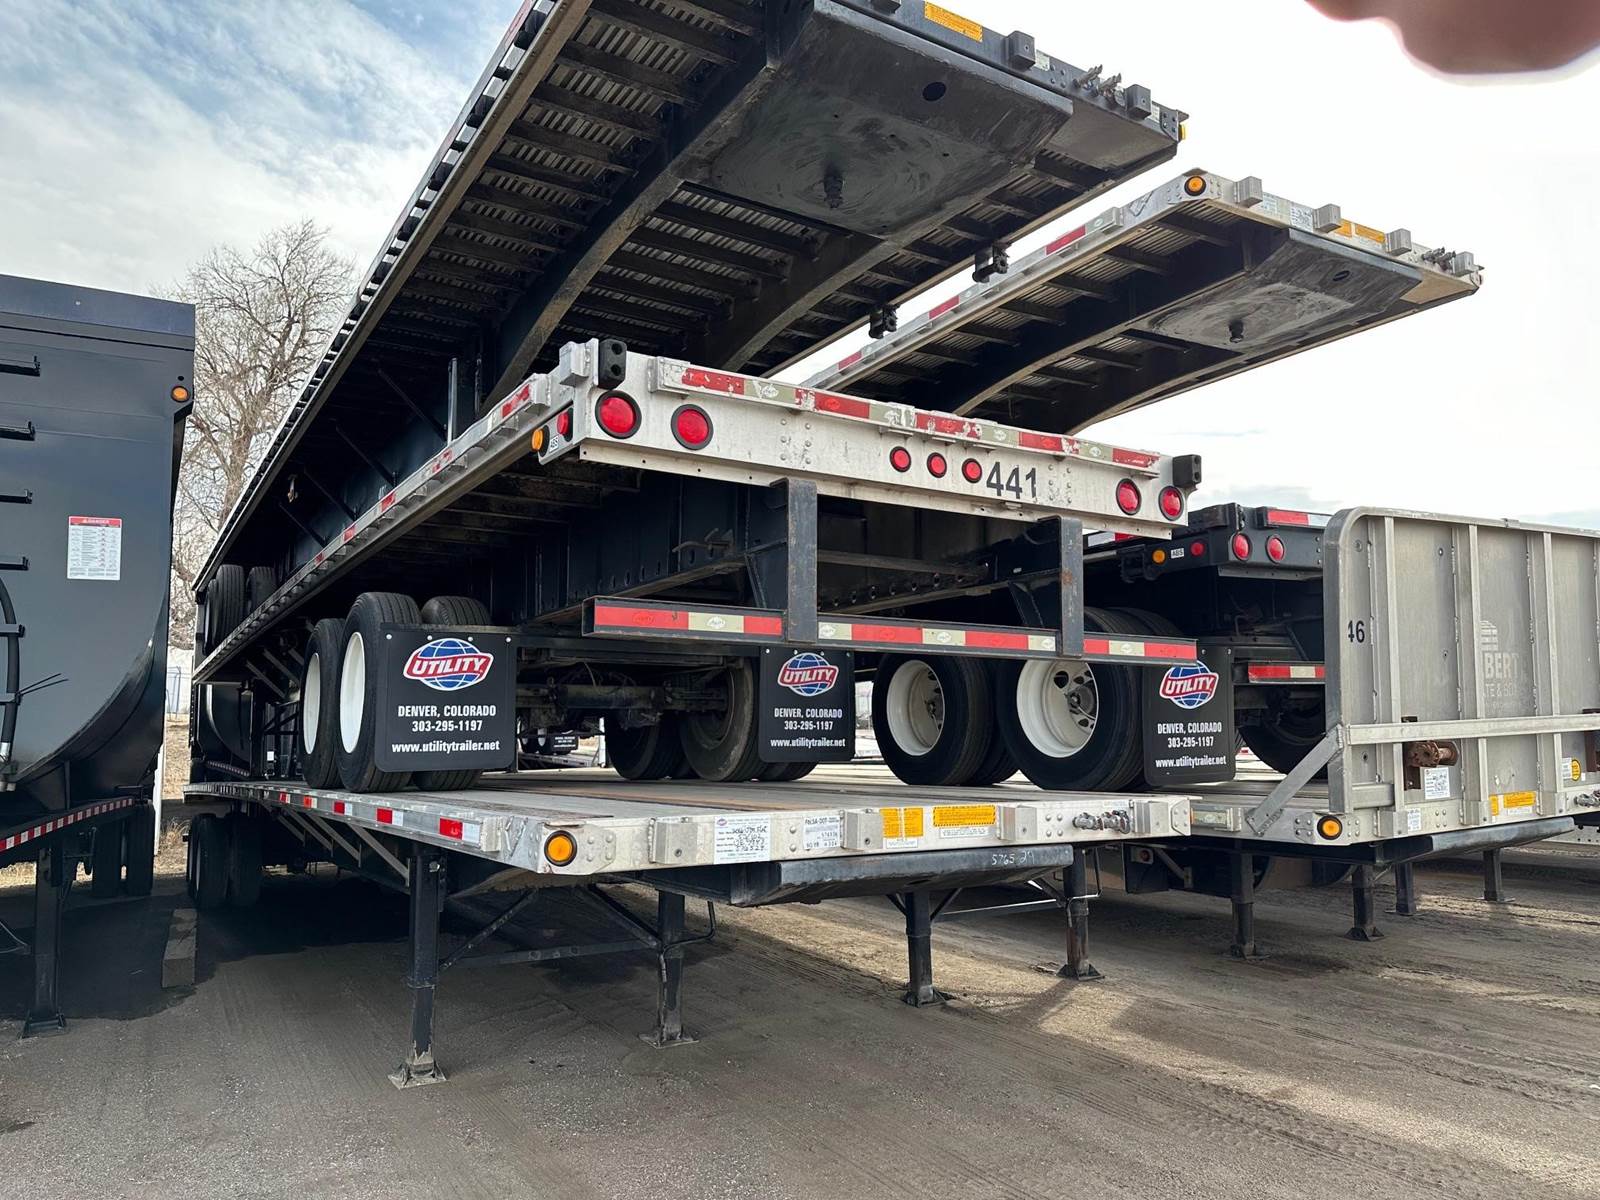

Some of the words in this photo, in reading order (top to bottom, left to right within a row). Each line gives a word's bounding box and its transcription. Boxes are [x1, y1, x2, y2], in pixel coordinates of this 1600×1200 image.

[986, 461, 1036, 499] 441
[412, 657, 486, 675] UTILITY
[783, 669, 834, 683] UTILITY
[1165, 677, 1214, 694] UTILITY
[398, 705, 440, 718] DENVER,
[443, 705, 497, 717] COLORADO
[774, 708, 804, 719] DENVER,
[805, 708, 843, 718] COLORADO
[412, 720, 483, 732] 303-295-1197
[784, 721, 834, 730] 303-295-1197
[1157, 723, 1186, 735] DENVER,
[1187, 722, 1222, 733] COLORADO
[391, 740, 500, 754] www.utilitytrailer.net
[770, 737, 846, 749] www.utilitytrailer.net
[1167, 736, 1214, 748] 303-295-1197
[1155, 755, 1227, 768] www.utilitytrailer.net
